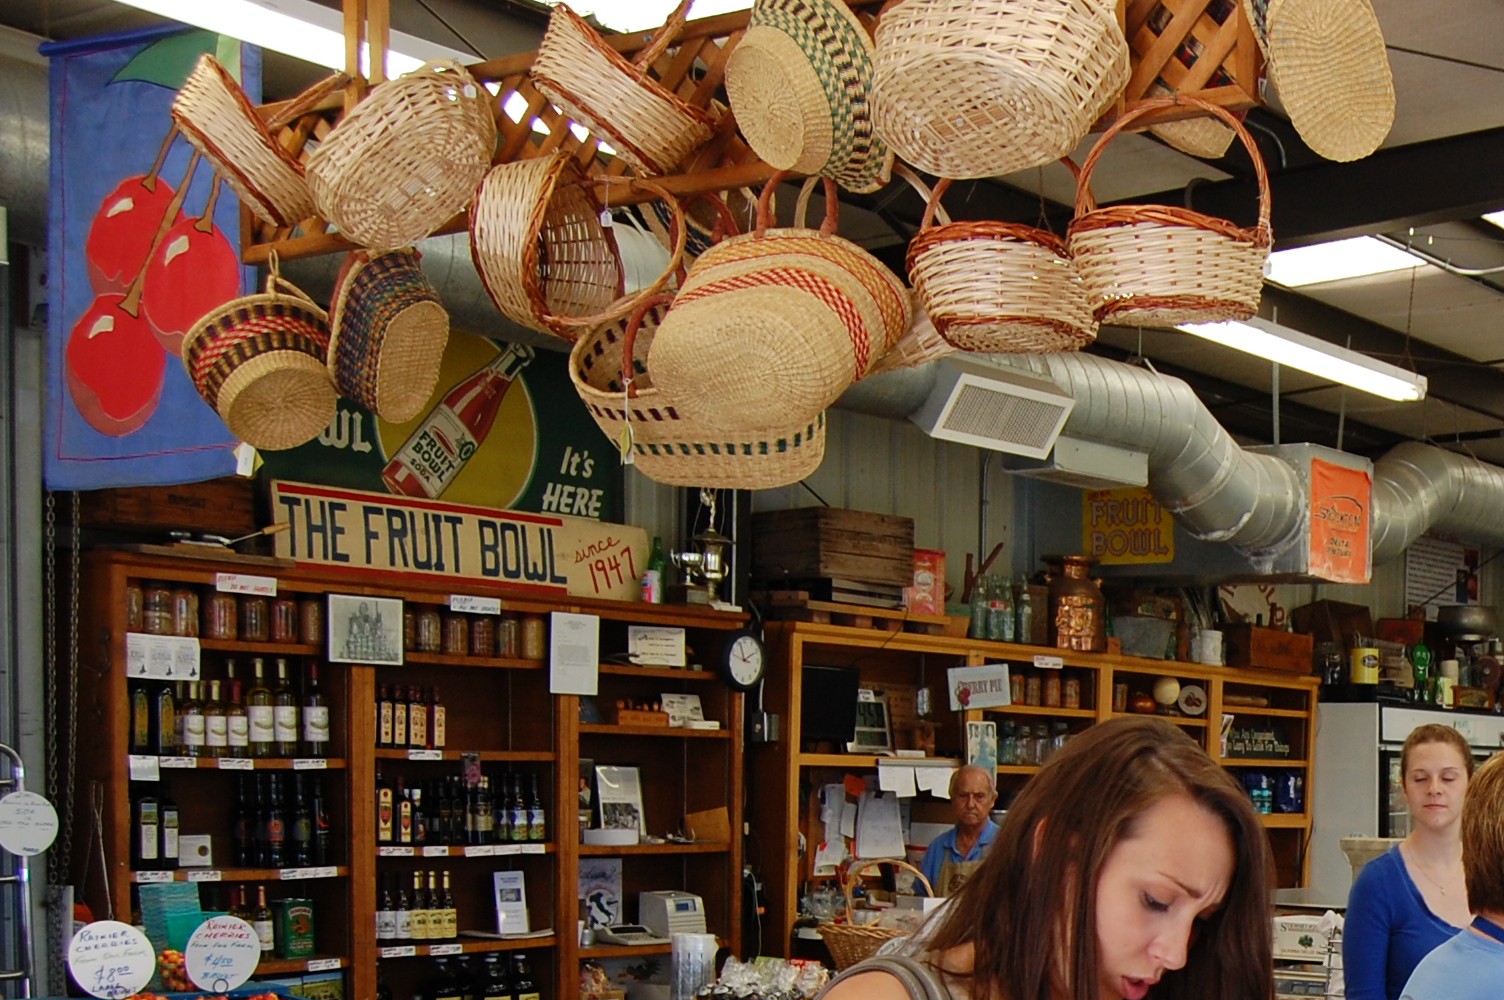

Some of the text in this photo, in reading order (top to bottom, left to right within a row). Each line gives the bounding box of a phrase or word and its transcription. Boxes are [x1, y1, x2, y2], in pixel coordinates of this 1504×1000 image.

[318, 409, 373, 453] WL
[411, 439, 454, 485] BOWL
[419, 427, 457, 473] FRUIT
[560, 446, 595, 479] It's
[409, 457, 431, 483] SODA
[543, 484, 604, 517] HERE
[1090, 497, 1162, 528] FRUIT
[279, 495, 568, 585] THE FRUIT BOWL
[574, 536, 621, 564] since
[1090, 527, 1170, 557] BOWL
[588, 546, 638, 594] 1947
[989, 678, 1003, 692] PIE
[80, 930, 129, 942] RAINIER
[206, 920, 247, 931] RAINIER
[76, 940, 138, 952] CHERRIES
